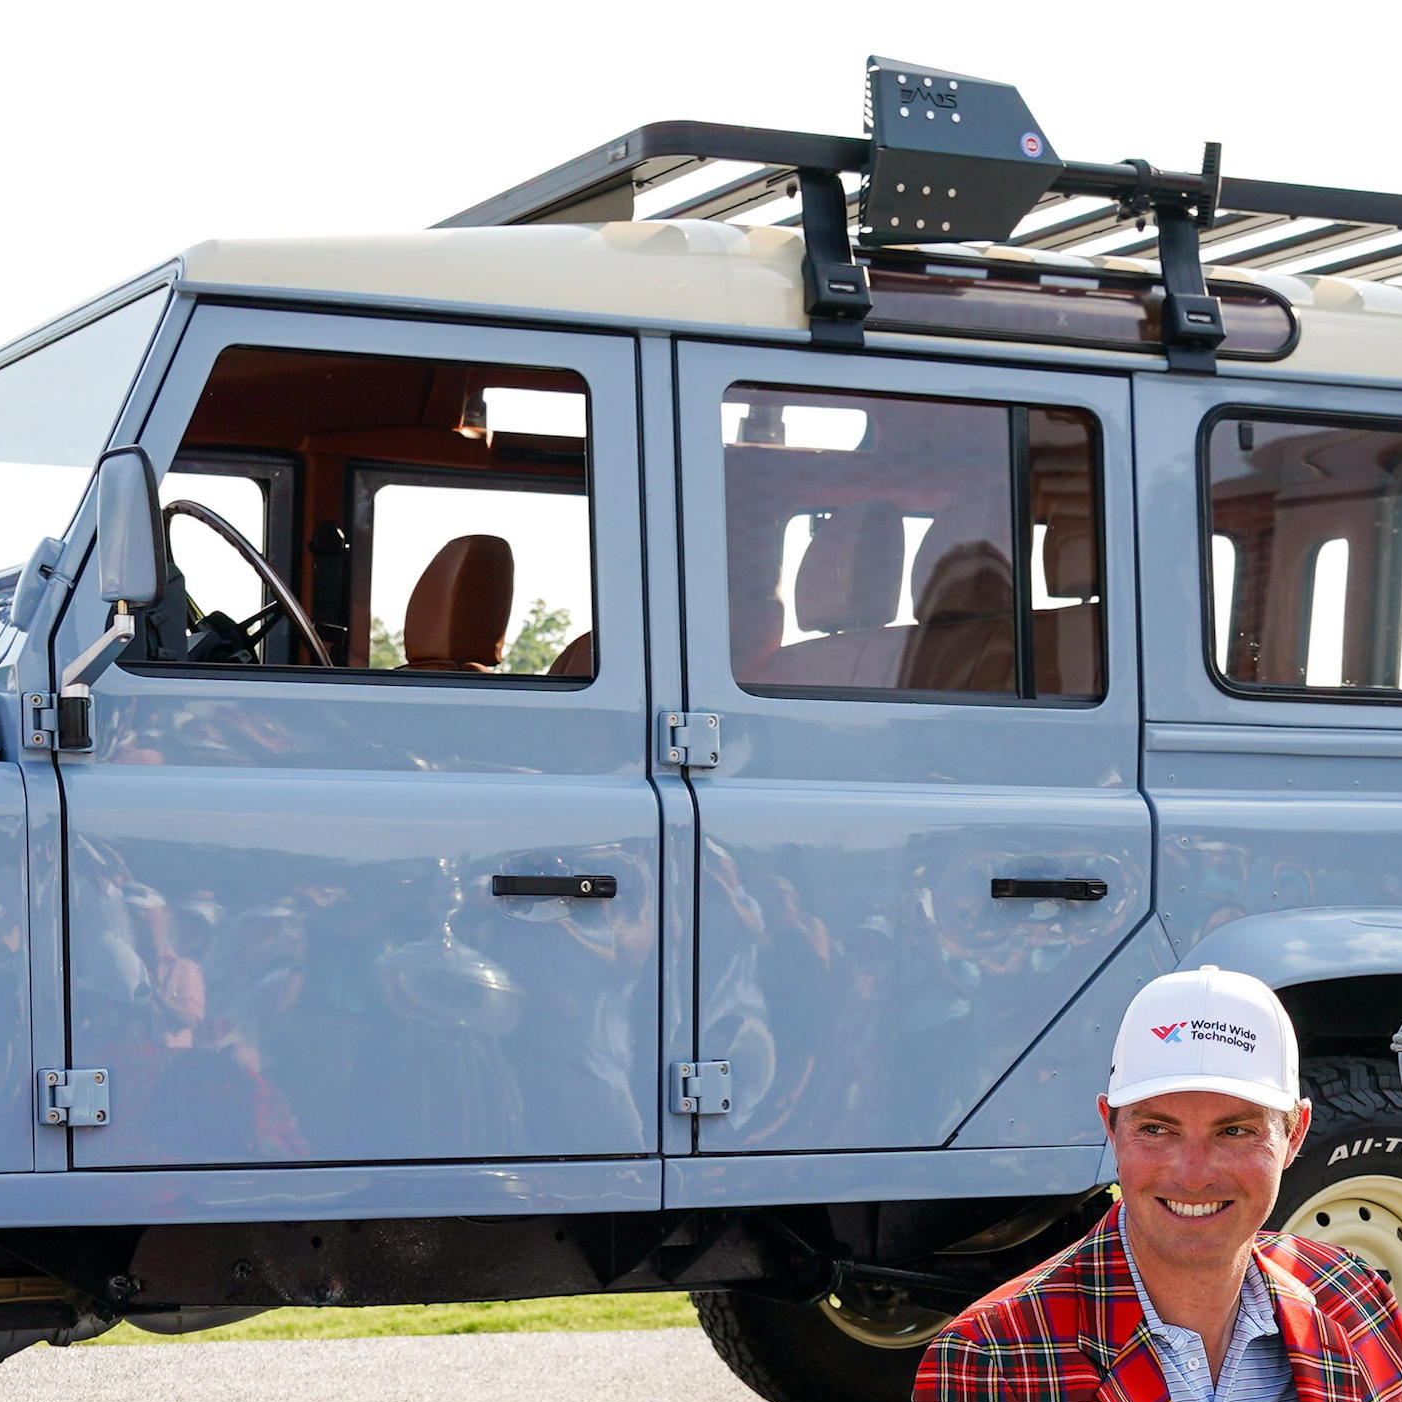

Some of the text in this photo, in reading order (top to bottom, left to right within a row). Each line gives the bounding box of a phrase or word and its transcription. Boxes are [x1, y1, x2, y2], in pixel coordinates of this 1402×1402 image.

[1191, 1020, 1257, 1041] World Wide
[1191, 1030, 1256, 1053] Technology
